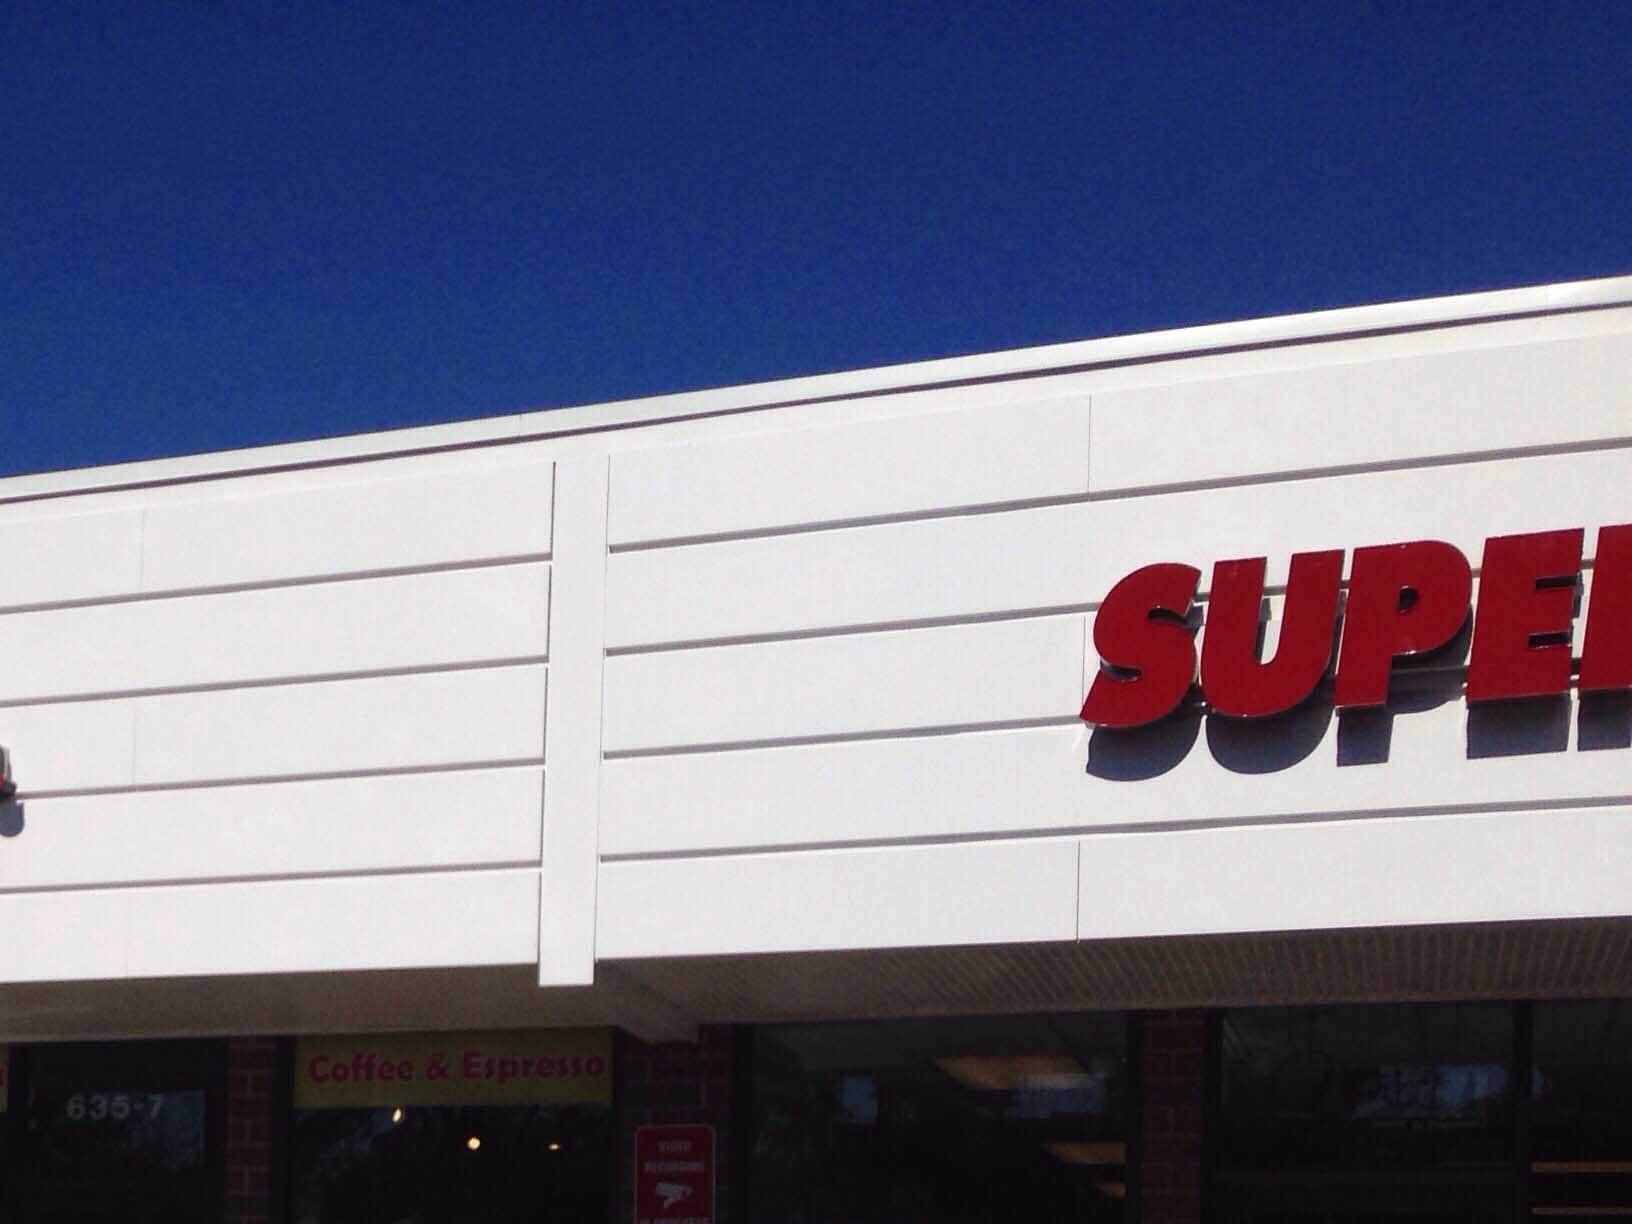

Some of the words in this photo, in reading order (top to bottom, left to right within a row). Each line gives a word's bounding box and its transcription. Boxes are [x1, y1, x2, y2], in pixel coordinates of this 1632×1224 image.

[309, 1054, 413, 1082] Coffee
[426, 1054, 449, 1081] &
[463, 1052, 606, 1084] Espresso
